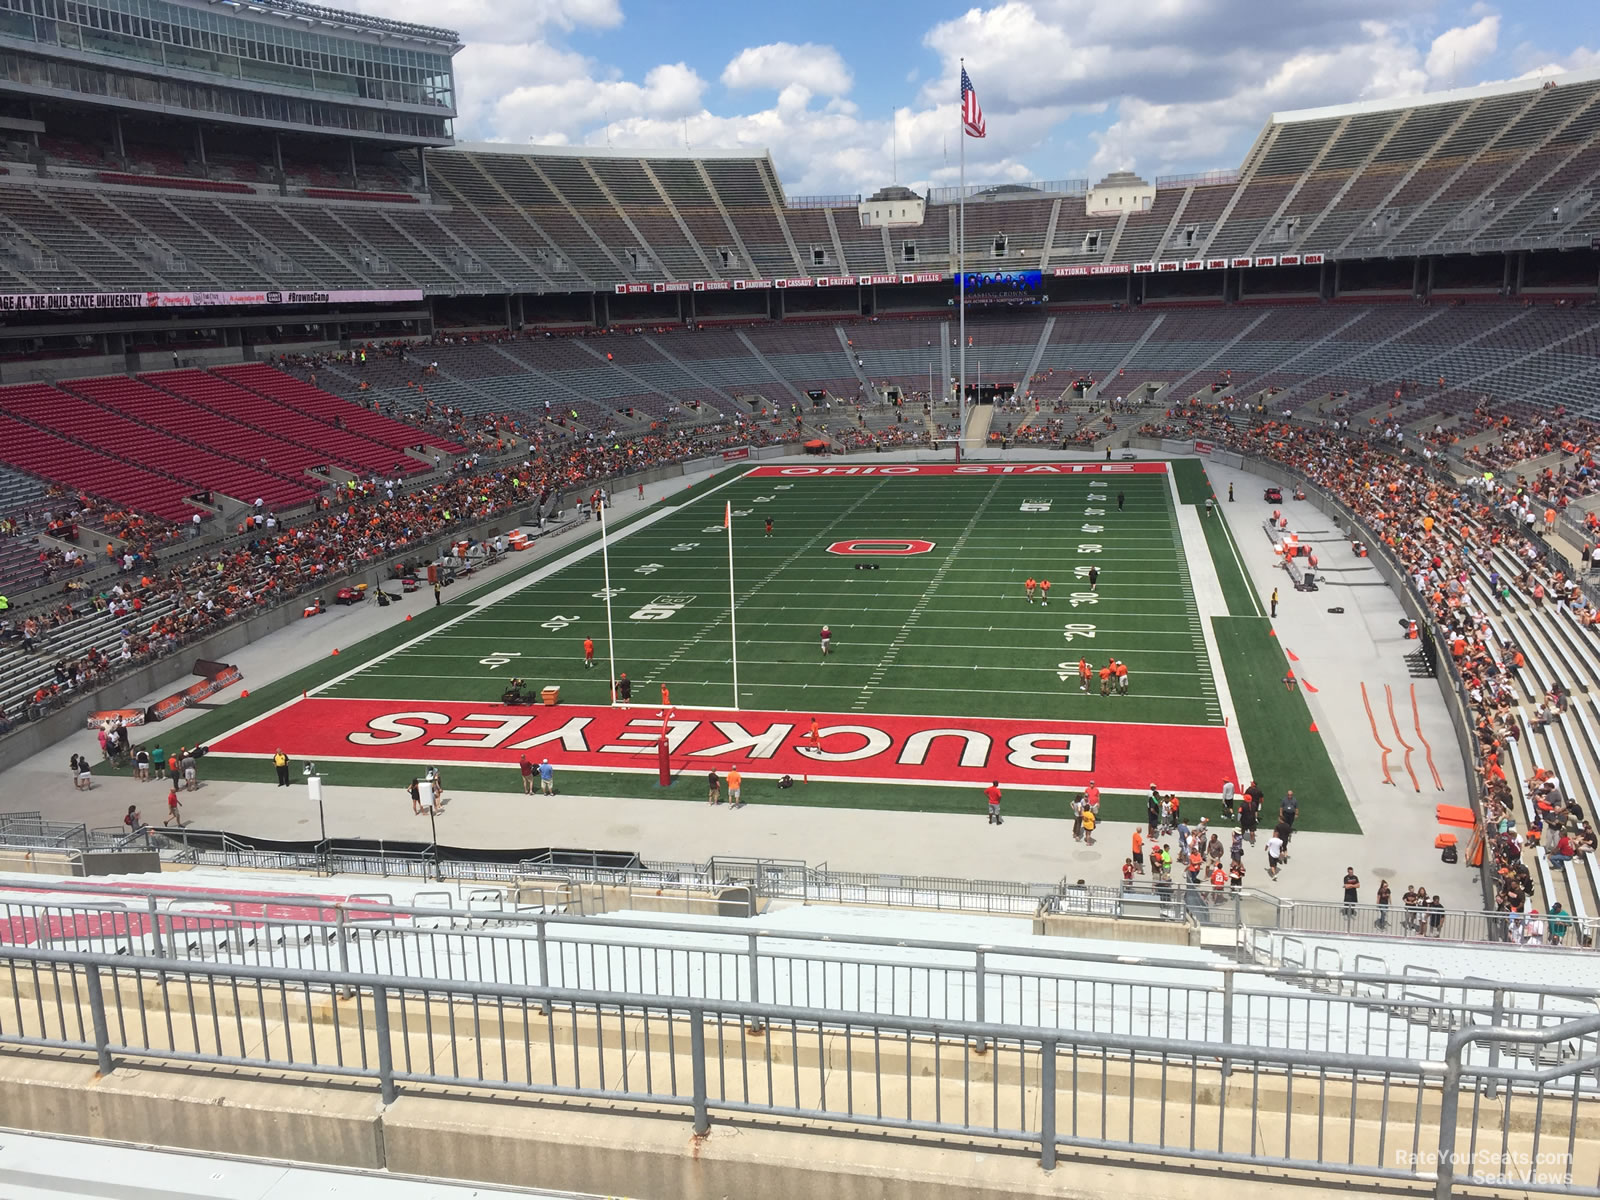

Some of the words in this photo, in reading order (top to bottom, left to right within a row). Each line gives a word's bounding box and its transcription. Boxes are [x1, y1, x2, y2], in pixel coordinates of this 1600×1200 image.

[1056, 268, 1088, 276] NATIONAL
[1090, 266, 1129, 274] CHAMPIONS
[830, 278, 854, 286] GRIFFIN
[16, 296, 27, 309] AT
[29, 296, 45, 308] THE
[48, 296, 68, 308] OHIO
[70, 295, 94, 308] STATE
[96, 294, 142, 308] UNIVERSITY
[288, 292, 330, 304] #BrownsCamp
[780, 466, 920, 476] OHIO
[953, 464, 1134, 474] STATE
[825, 538, 936, 556] O
[1077, 544, 1102, 553] 50
[540, 615, 581, 628] 20
[1064, 624, 1096, 638] 20
[479, 652, 522, 665] 10
[347, 711, 1096, 772] BUCKEYES
